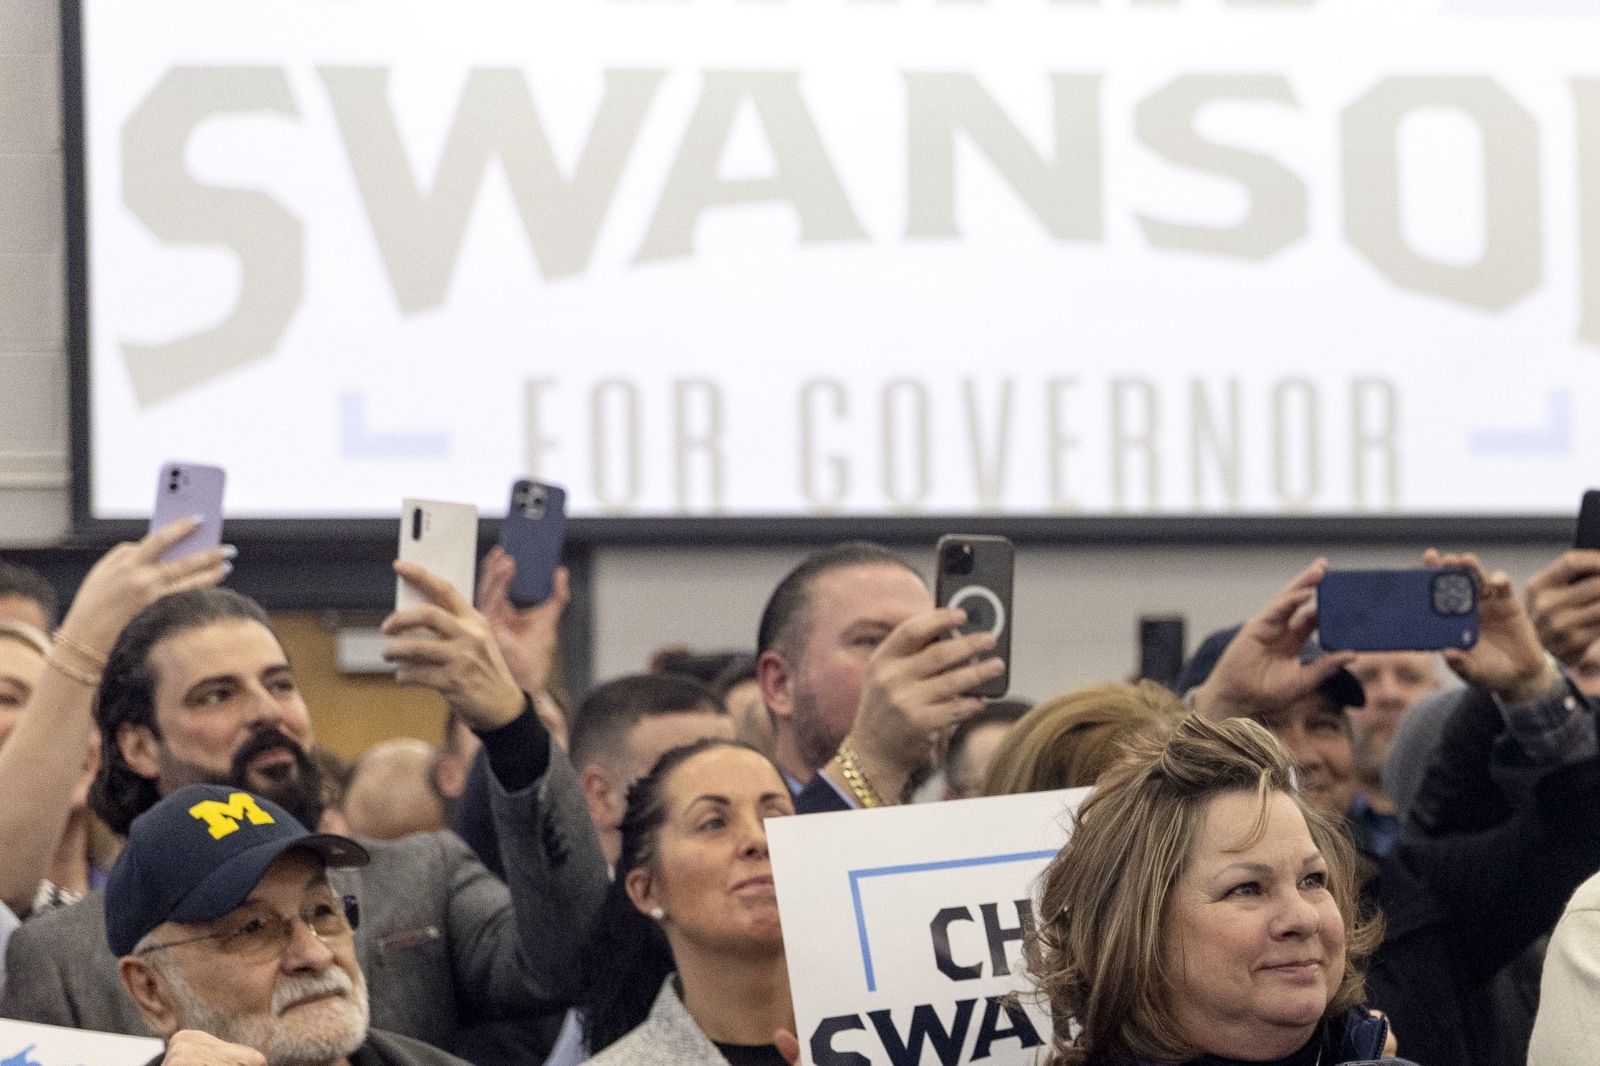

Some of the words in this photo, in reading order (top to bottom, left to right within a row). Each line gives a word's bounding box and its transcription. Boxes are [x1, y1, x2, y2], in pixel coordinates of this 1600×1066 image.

[523, 374, 724, 515] FOR
[797, 374, 1401, 515] GOVERNOR
[189, 792, 276, 840] M
